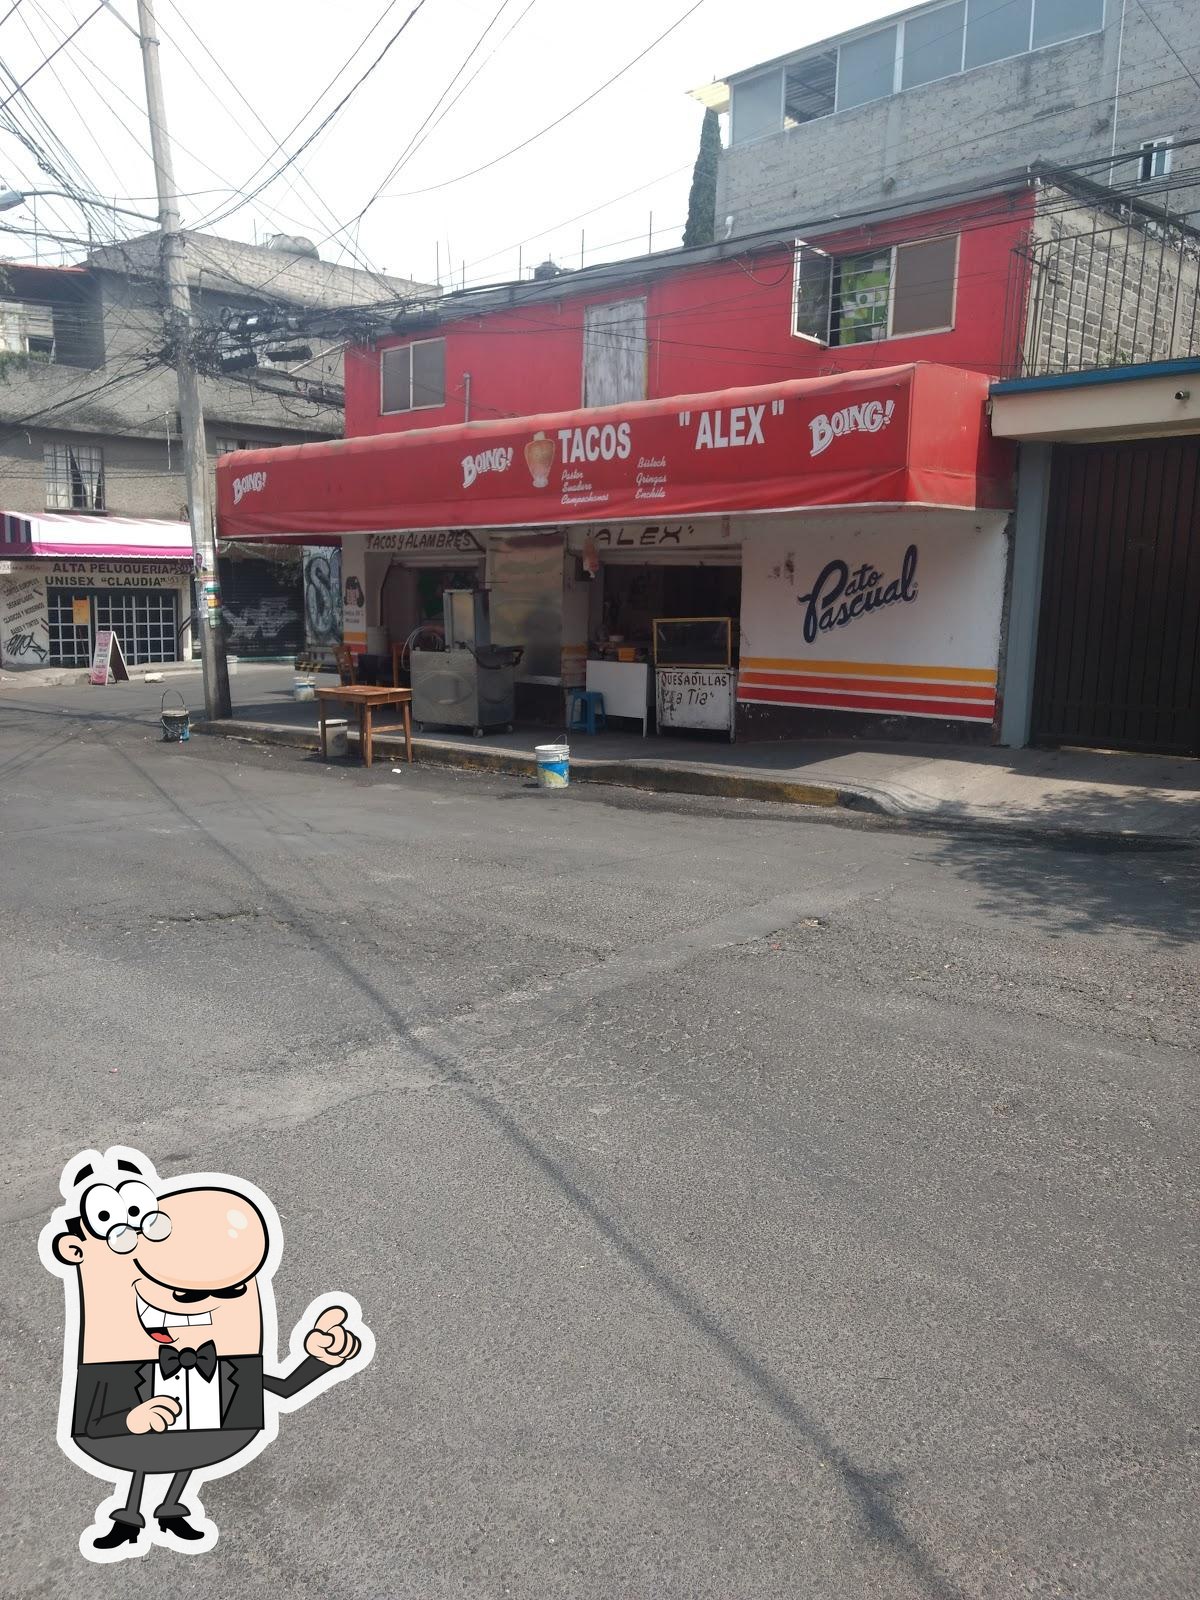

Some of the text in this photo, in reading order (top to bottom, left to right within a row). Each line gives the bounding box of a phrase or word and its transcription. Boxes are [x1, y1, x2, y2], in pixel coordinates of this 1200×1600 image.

[808, 400, 895, 457] BOING!
[558, 422, 631, 464] TACOS
[461, 447, 513, 488] BOING!
[561, 469, 583, 480] Pastor
[636, 473, 667, 486] Gringas
[233, 472, 267, 505] BOING!
[367, 533, 396, 550] TACOS
[405, 531, 471, 548] ALAMBRES
[53, 562, 87, 573] ALTA
[91, 562, 171, 574] PELUQUERIA
[45, 576, 95, 586] UNISEX
[101, 576, 166, 586] "CLAUDIA"
[661, 672, 727, 687] QUESADILLAS
